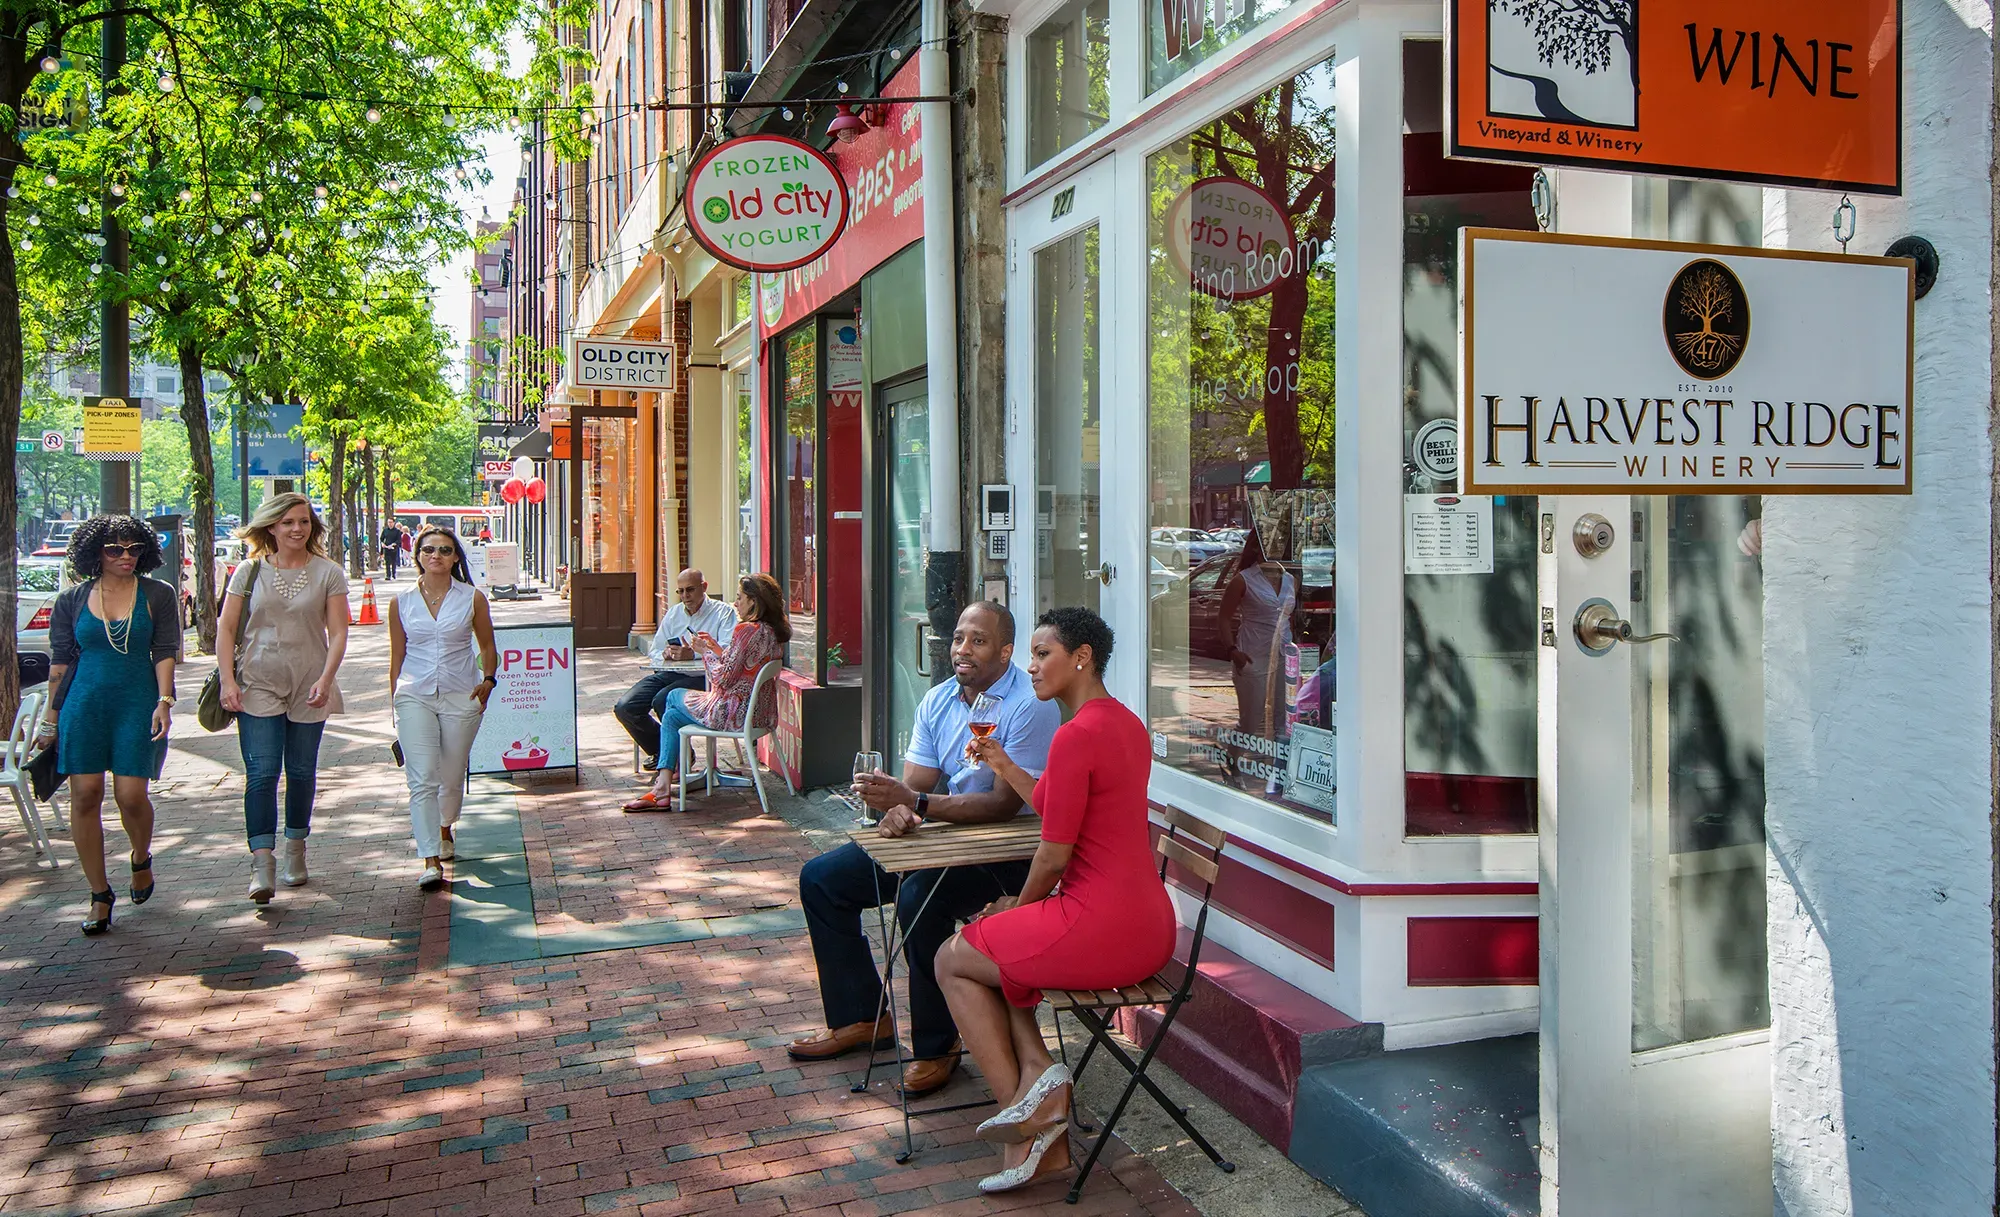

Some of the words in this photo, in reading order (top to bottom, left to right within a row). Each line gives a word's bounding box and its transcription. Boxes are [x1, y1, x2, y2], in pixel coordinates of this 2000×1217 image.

[1684, 22, 1859, 100] WINE
[901, 102, 921, 135] COFF
[1477, 120, 1552, 144] Vineyard
[1556, 130, 1572, 146] &
[1576, 131, 1643, 155] Winery
[908, 138, 922, 166] JUI
[714, 154, 810, 178] FROZEN
[774, 183, 833, 219] city
[846, 147, 895, 234] RÊPES
[893, 176, 924, 217] SMOOTH
[1051, 185, 1076, 220] 227
[722, 224, 822, 249] YOGURT
[1192, 266, 1235, 308] ting
[1245, 236, 1320, 290] Room
[582, 348, 622, 363] OLD
[627, 350, 670, 365] CITY
[1696, 339, 1718, 360] 47
[585, 366, 667, 383] DISTRICT
[1194, 373, 1227, 407] ine
[1237, 360, 1301, 402] Shop
[1678, 384, 1701, 392] EST.
[1708, 385, 1733, 393] 2010
[236, 431, 263, 439] Btsy
[481, 435, 526, 449] sna
[1426, 440, 1452, 449] BEST
[1481, 394, 1734, 468] HARVEST
[1752, 400, 1901, 470] RIDGE
[486, 462, 512, 471] CVS
[1436, 457, 1455, 465] 2012
[1624, 455, 1782, 478] WINERY
[498, 647, 569, 672] PEN
[510, 680, 541, 688] Crêpes
[524, 671, 553, 679] Yogurt
[780, 686, 802, 731] ZEN
[1216, 727, 1290, 760] ACCESSORIES
[1189, 743, 1227, 766] ARTIES
[1237, 756, 1286, 787] CLASSES
[1305, 764, 1333, 787] Drink
